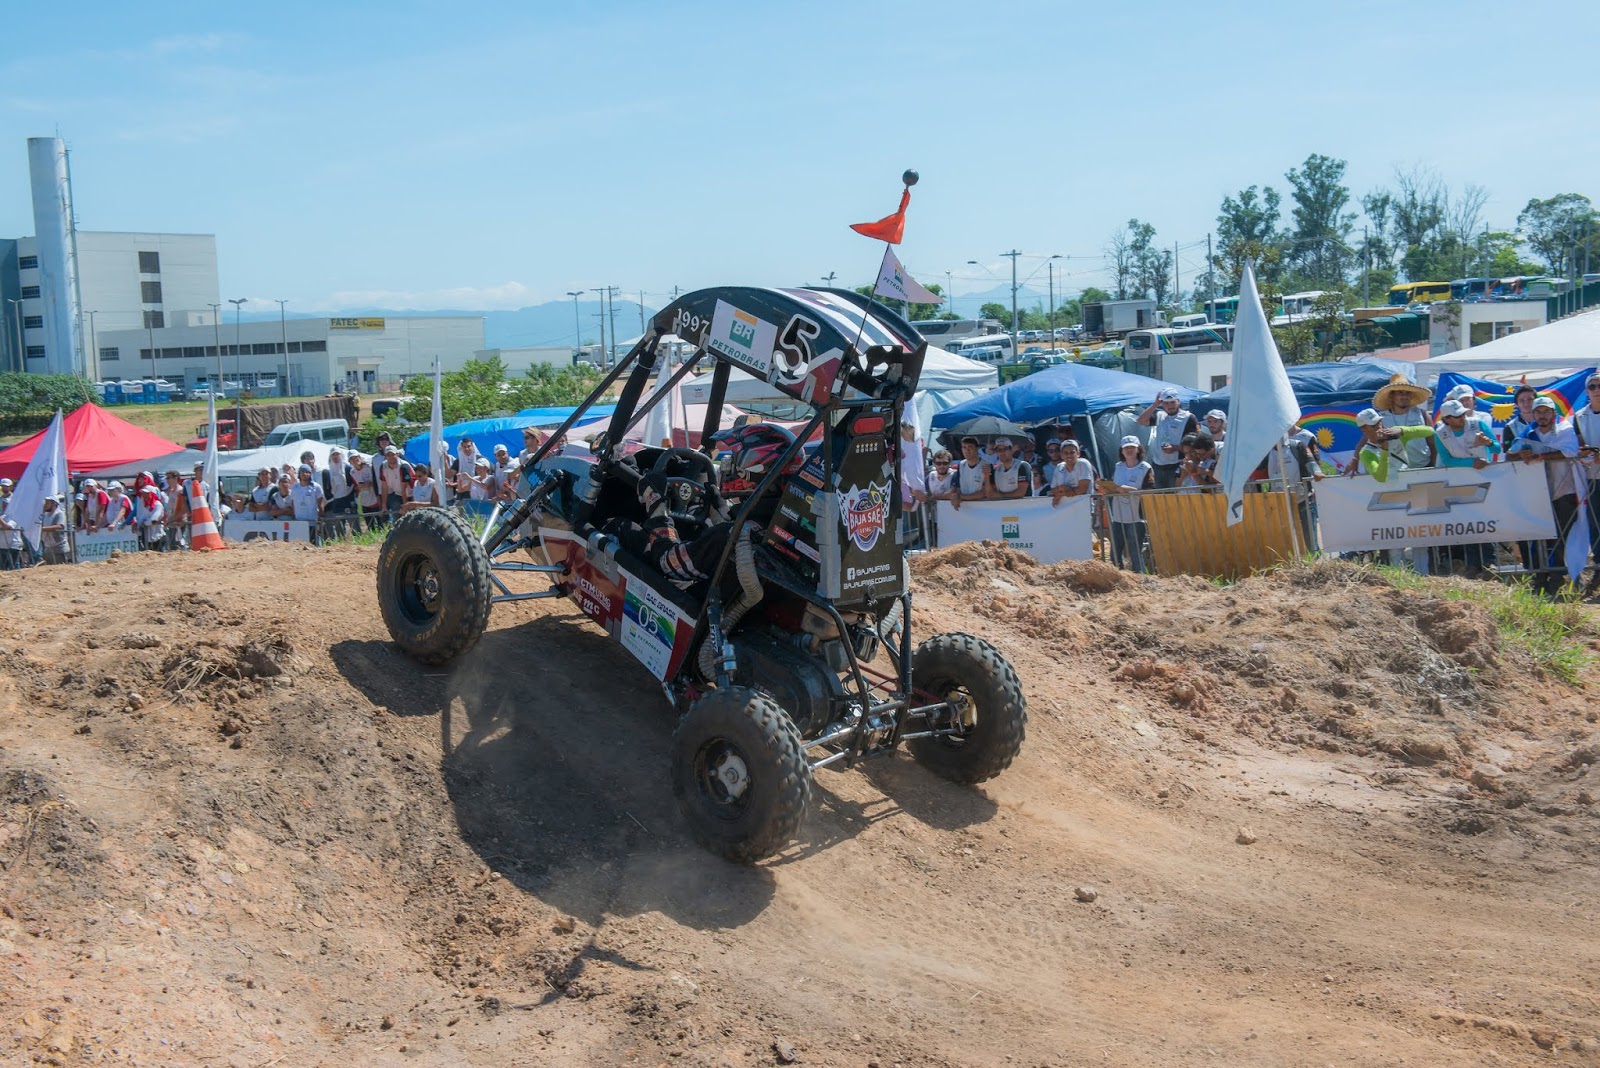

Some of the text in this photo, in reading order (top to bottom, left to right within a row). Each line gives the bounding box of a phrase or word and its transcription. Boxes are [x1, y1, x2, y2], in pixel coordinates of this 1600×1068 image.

[331, 318, 359, 326] FATEC
[676, 308, 710, 334] 1997
[732, 322, 754, 342] BR
[711, 338, 767, 370] PETROBRAS
[773, 313, 821, 385] 5
[849, 508, 881, 530] BAJA SAE
[1003, 524, 1018, 534] BR
[1371, 520, 1497, 541] FIND NEW ROADS
[638, 604, 659, 635] 05
